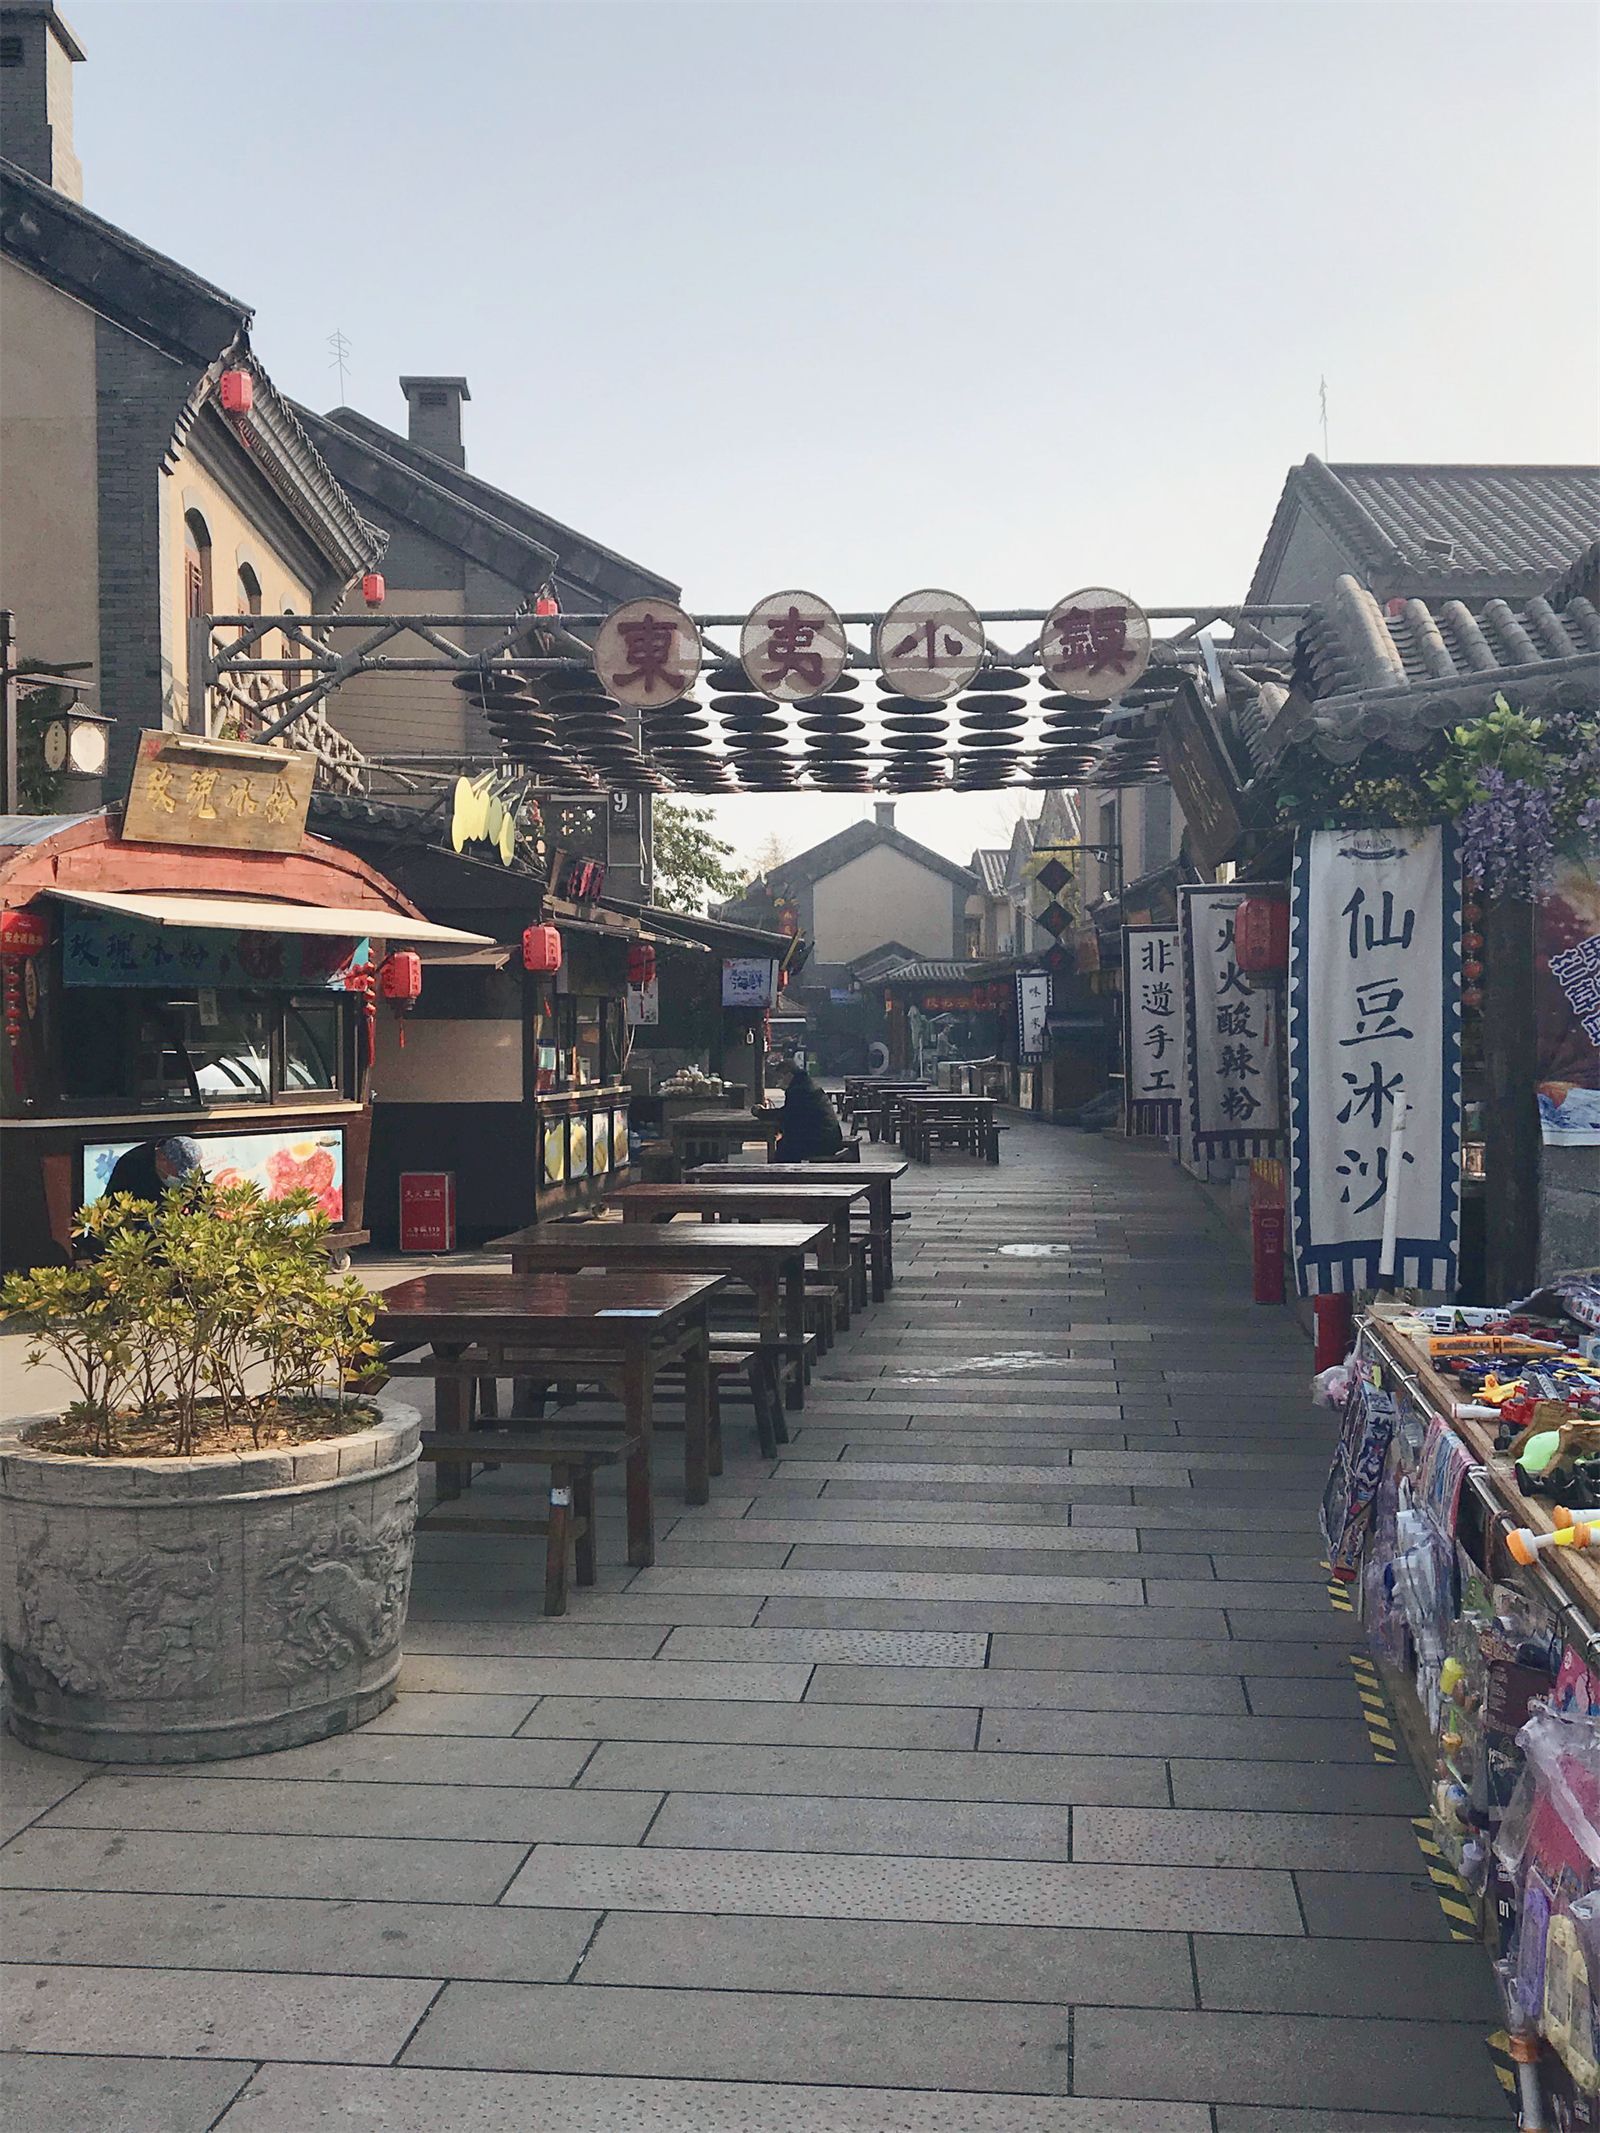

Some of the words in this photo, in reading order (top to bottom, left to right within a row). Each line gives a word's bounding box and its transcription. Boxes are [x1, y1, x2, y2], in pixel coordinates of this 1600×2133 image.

[145, 763, 299, 825] 玫瑰冰粉
[1140, 937, 1177, 1093] 非遗手工
[1214, 918, 1261, 1122] 火火酸辣粉
[1336, 886, 1415, 1217] 仙豆冰沙
